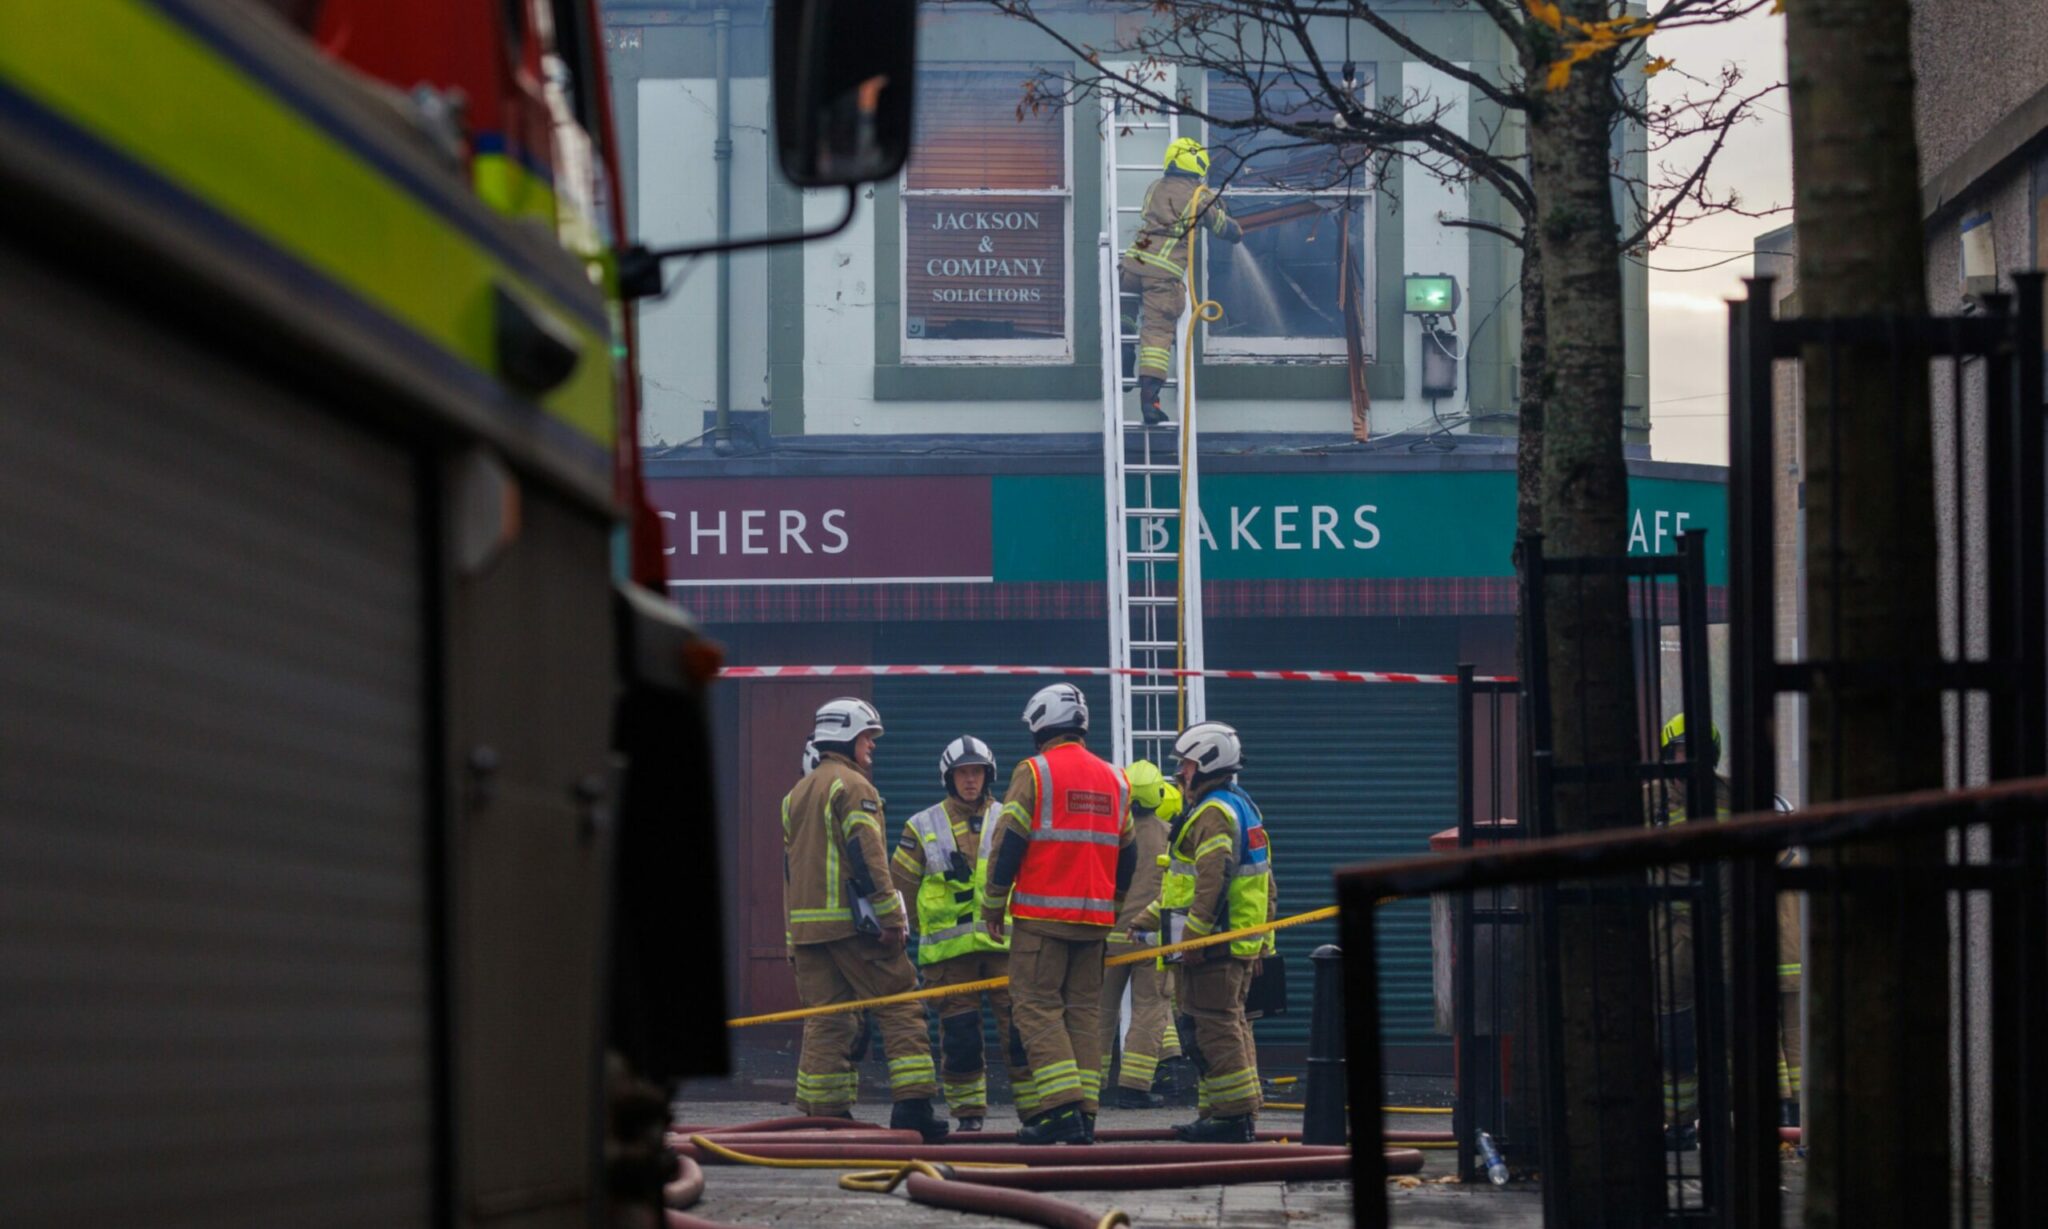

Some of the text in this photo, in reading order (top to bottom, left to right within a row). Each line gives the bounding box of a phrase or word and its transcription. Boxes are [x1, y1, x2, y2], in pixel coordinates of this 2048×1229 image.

[931, 211, 1041, 231] JACKSON
[978, 235, 994, 253] &
[926, 258, 1046, 277] COMPANY
[932, 287, 1041, 303] SOLICITORS
